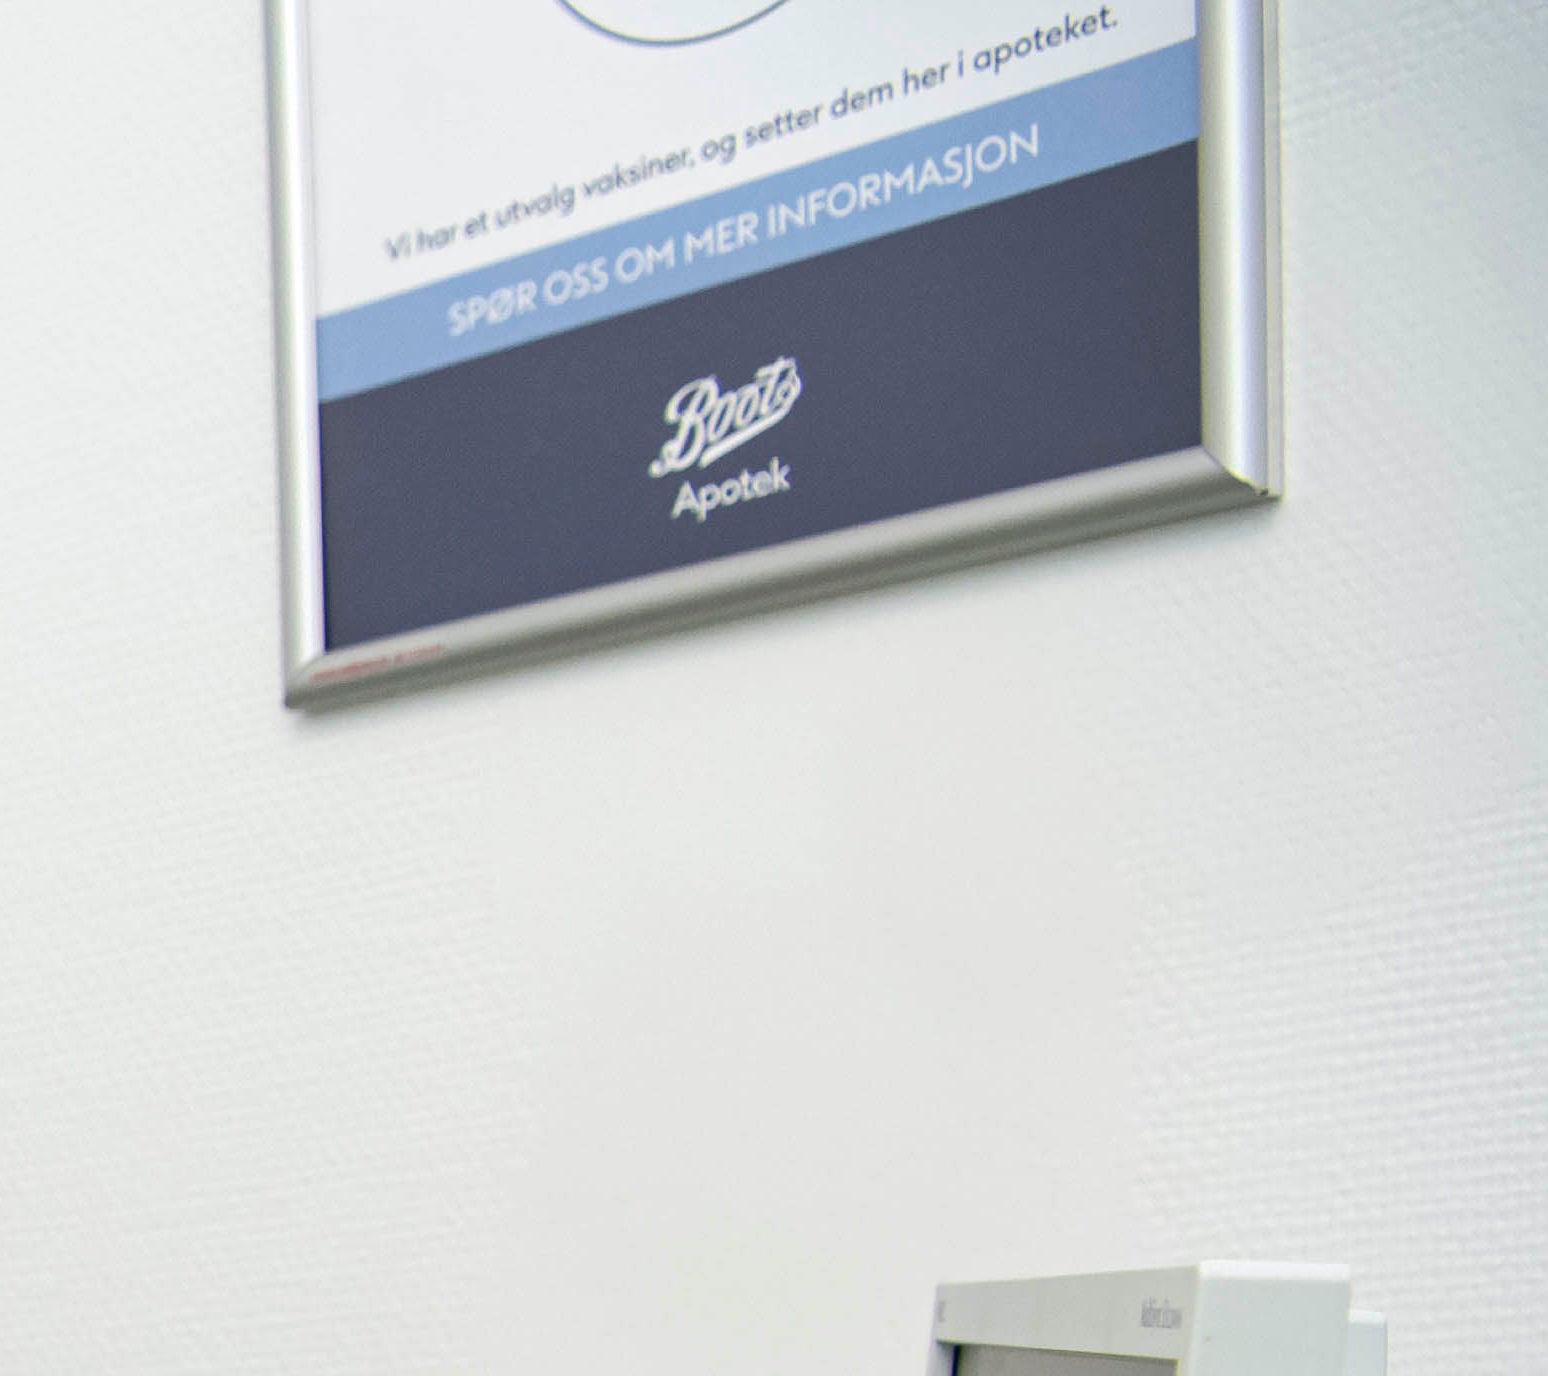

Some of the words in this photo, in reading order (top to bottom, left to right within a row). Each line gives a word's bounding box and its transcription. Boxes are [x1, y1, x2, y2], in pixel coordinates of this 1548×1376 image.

[386, 232, 411, 261] Vi
[415, 225, 457, 255] har
[464, 210, 488, 239] et
[495, 184, 576, 230] utvalg
[582, 146, 695, 197] vaksiner,
[701, 132, 737, 166] og
[745, 103, 823, 148] setter
[830, 79, 894, 120] dem
[902, 61, 951, 96] her
[958, 51, 964, 75] i
[973, 5, 1119, 74] apoteket.
[448, 279, 537, 337] SPØR
[543, 256, 608, 306] OSS
[615, 236, 675, 284] OM
[684, 211, 758, 264] MER
[767, 123, 1038, 240] INFORMASJON
[648, 356, 802, 478] Boots
[670, 456, 791, 523] Apotek
